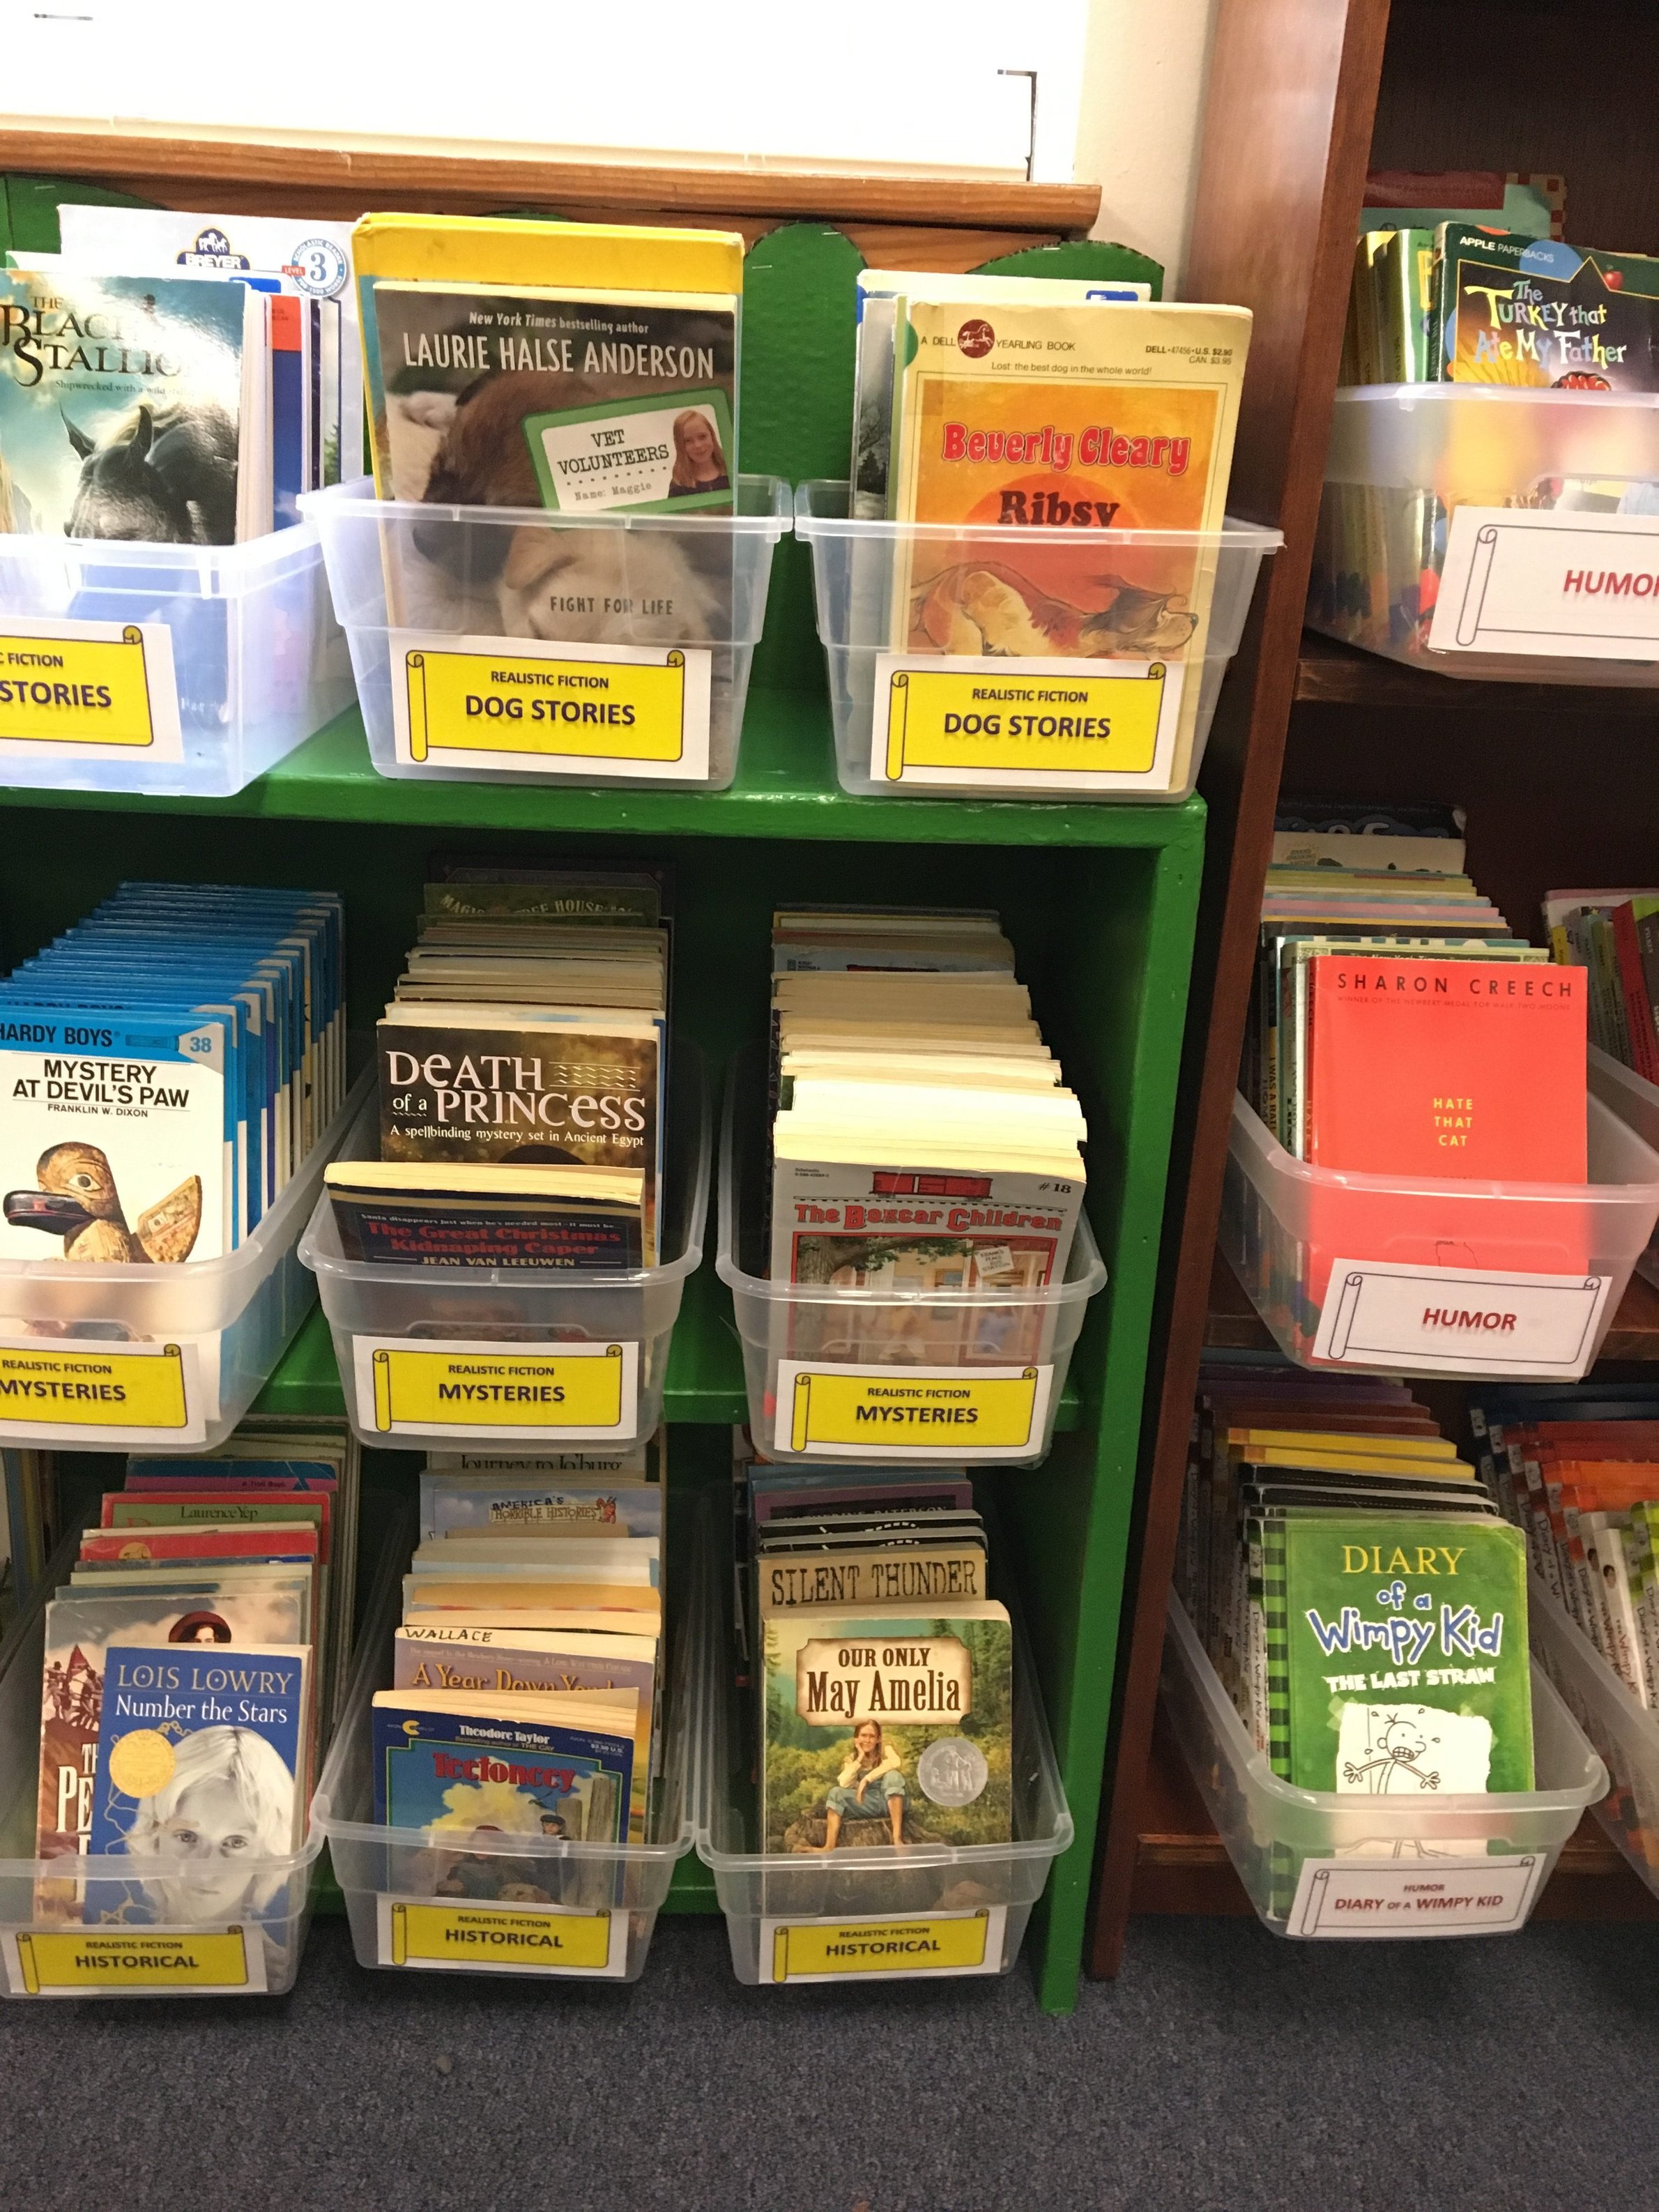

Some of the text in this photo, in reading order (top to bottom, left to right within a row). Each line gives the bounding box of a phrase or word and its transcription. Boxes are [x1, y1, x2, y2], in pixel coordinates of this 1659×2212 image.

[1460, 236, 1555, 264] APPLE PAPERBACKS
[185, 253, 242, 268] BREYER
[284, 266, 303, 275] LEVEL
[310, 252, 326, 282] 3
[1513, 280, 1543, 303] The
[32, 296, 63, 309] THE
[1465, 285, 1607, 330] TURKEY that
[469, 312, 649, 335] New York Times bestselling author
[921, 337, 1076, 351] A DELL YEARLING BOOK
[1473, 329, 1628, 370] Ate My Father
[403, 333, 714, 379] LAURIE HALSE ANDERSON
[1015, 362, 1152, 376] the best dog in the whole world!
[56, 379, 136, 392] Shipwrecked with
[591, 429, 626, 448] VET
[942, 422, 1192, 476] Beverly Cleary
[558, 444, 670, 476] VOLUNTEERS
[574, 481, 652, 501] Name: Maggie
[1563, 570, 1659, 597] HUMO
[550, 596, 673, 616] FIGHT FOR LIFE
[8, 652, 64, 667] FICTION
[491, 670, 609, 689] REALISTIC FICTION
[0, 680, 112, 708] STORIES
[972, 688, 1089, 703] REALISTIC FICTION
[466, 694, 636, 726] DOG STORIES
[944, 712, 1111, 739] DOG STORIES
[1338, 972, 1572, 998] SHARON CREECH
[1338, 996, 1369, 1005] WINNER
[1444, 1000, 1471, 1008] MEDAL
[64, 1026, 113, 1047] BOYS
[190, 1036, 212, 1053] 38
[43, 1059, 158, 1084] MYSTERY
[13, 1080, 190, 1108] AT DEVIL'S PAW
[392, 1092, 413, 1111] of
[418, 1098, 427, 1111] a
[47, 1104, 148, 1118] FRANKLIN W. DIXON
[1433, 1098, 1473, 1111] HATE
[1435, 1116, 1472, 1129] THAT
[390, 1124, 645, 1148] A spellbinding mystery set in Ancient Egypt
[1439, 1134, 1467, 1147] CAT
[794, 1203, 1063, 1233] The Boxcar Children
[367, 1221, 621, 1243] The Great Christmas
[390, 1237, 599, 1256] Kidnaping Caper
[421, 1256, 575, 1267] JEAN VAN LEEUWEN
[1423, 1306, 1517, 1331] HUMOR
[2, 1359, 112, 1374] REALISTIC FICTION
[448, 1364, 555, 1376] REALISTIC FICTION
[0, 1379, 126, 1401] MYSTERIES
[438, 1383, 565, 1402] MYSTERIES
[867, 1387, 970, 1398] REALISTIC FICTION
[856, 1405, 978, 1423] MYSTERIES
[492, 1496, 564, 1511] AMERICA'S
[495, 1506, 598, 1520] HORRIBLE HISTORIES
[181, 1505, 259, 1523] Laurence Yep
[1341, 1545, 1467, 1576] DIARY
[771, 1559, 978, 1607] SILENT THUNDER
[1377, 1580, 1432, 1610] of a
[404, 1627, 492, 1642] WALLACE
[1306, 1604, 1504, 1665] Wimpy Kid
[838, 1647, 931, 1668] OUR ONLY
[118, 1665, 294, 1695] LOIS LOWRY
[412, 1662, 431, 1686] A
[435, 1663, 490, 1690] Year
[1327, 1667, 1495, 1693] THE LAST STRAW
[806, 1670, 961, 1719] May Amelia
[116, 1695, 288, 1724] Number the Stars
[459, 1725, 551, 1746] Theodore Taylor
[431, 1752, 576, 1794] Teetoncey
[1403, 1884, 1444, 1893] HUMOR
[1334, 1894, 1504, 1912] DIARY OF A WIMPY KID
[458, 1914, 551, 1928] REALISTIC FICTION
[445, 1927, 563, 1948] HISTORICAL
[839, 1925, 930, 1939] REALISTIC FICTION
[86, 1940, 183, 1950] REALISTIC FICTION
[825, 1938, 941, 1958] HISTORICAL
[76, 1953, 199, 1969] HISTORICAL
